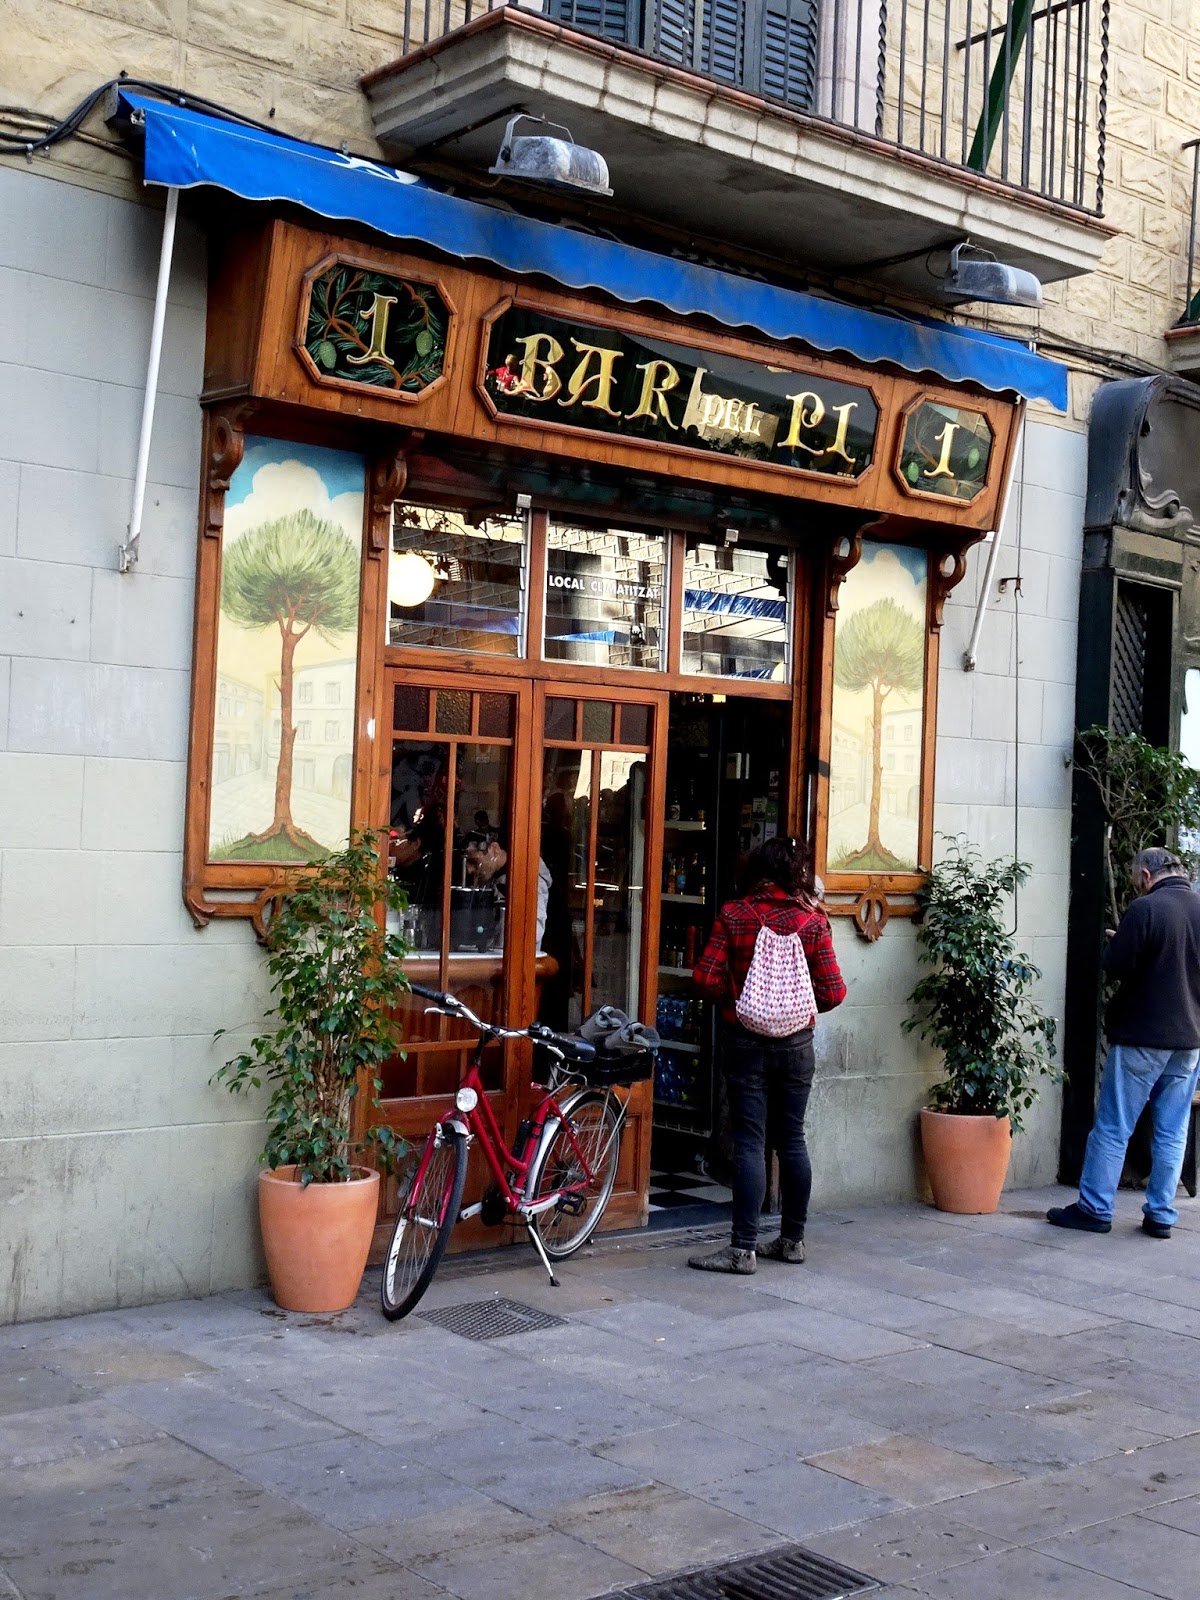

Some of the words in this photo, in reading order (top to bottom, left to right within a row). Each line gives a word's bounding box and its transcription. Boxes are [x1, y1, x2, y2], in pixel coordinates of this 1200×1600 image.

[514, 332, 680, 431] BAR
[698, 394, 761, 437] DEL
[777, 390, 859, 464] PI
[548, 574, 586, 590] LOCAL
[590, 580, 660, 599] CLIMATITZAT
